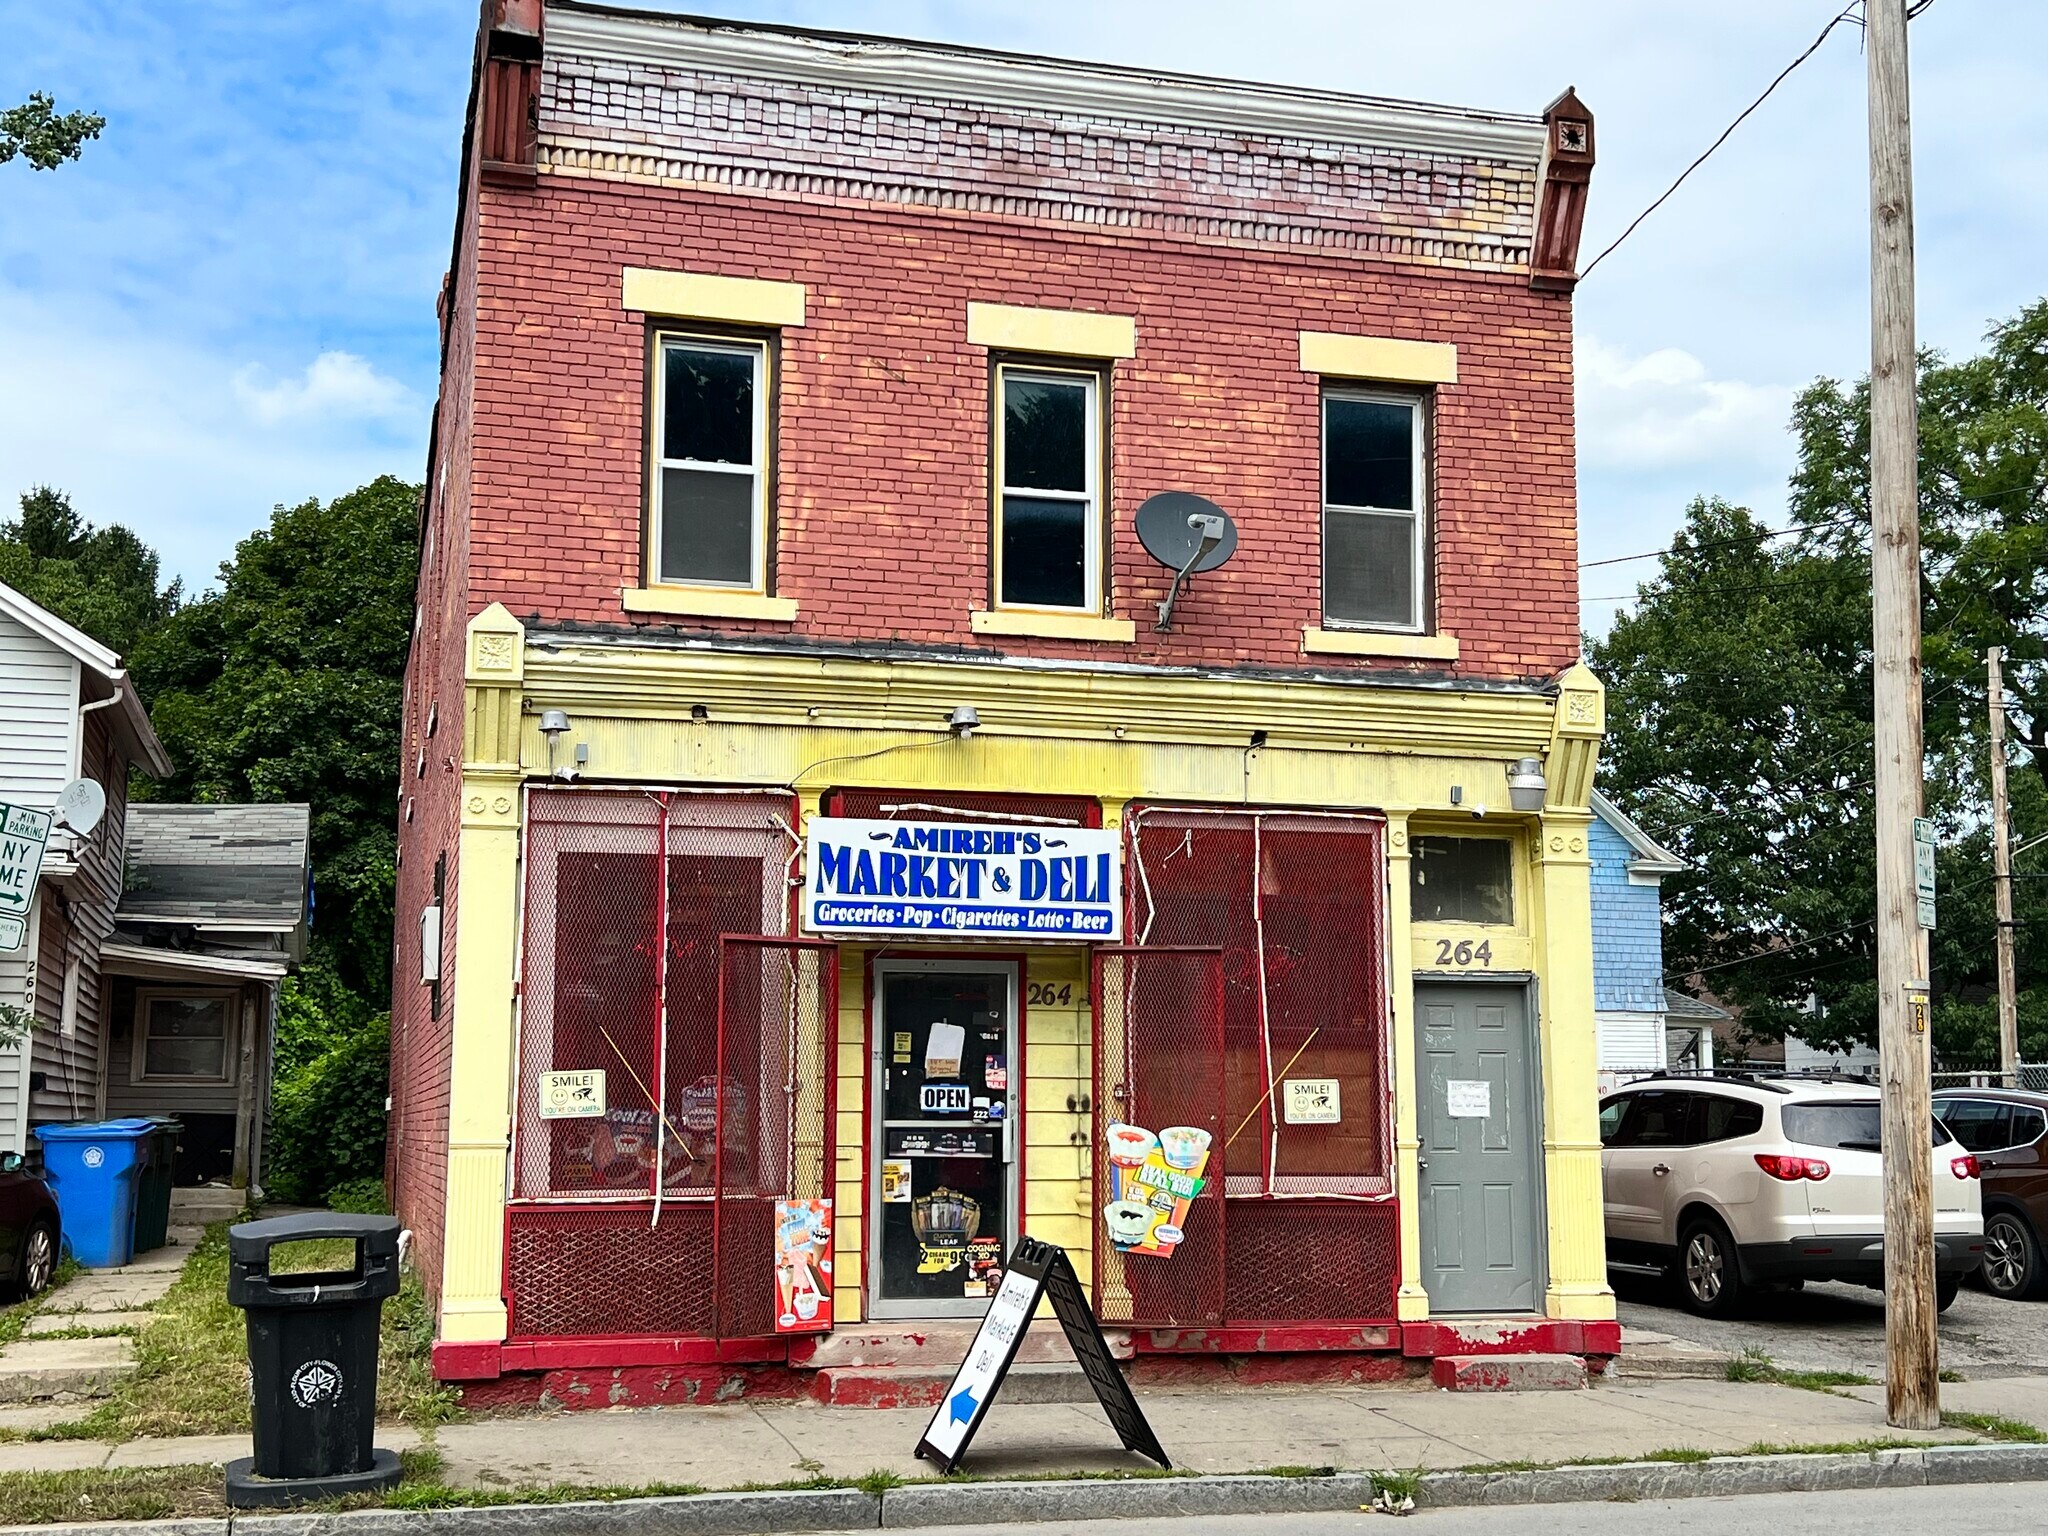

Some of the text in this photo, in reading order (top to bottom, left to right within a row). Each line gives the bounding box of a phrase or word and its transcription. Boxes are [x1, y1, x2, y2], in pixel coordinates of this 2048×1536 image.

[19, 811, 37, 825] MIN
[9, 820, 44, 840] PARKING
[892, 827, 1041, 855] AMIREH'S
[2, 840, 31, 863] NY
[0, 865, 28, 888] ME
[815, 842, 1111, 903] MARKET & DELI
[818, 903, 1109, 930] Groceries Pop Cigarettes Lotto Beer
[0, 924, 18, 933] HERS
[1435, 939, 1492, 966] 264
[25, 961, 36, 1004] 260
[1028, 982, 1071, 1006] 264
[551, 1075, 594, 1088] SMILE!
[1294, 1085, 1330, 1095] SMILE!
[924, 1088, 966, 1108] OPEN
[544, 1106, 566, 1114] YOU'RE
[578, 1105, 601, 1113] CAMERA
[1139, 1171, 1169, 1190] REAL
[1141, 1164, 1167, 1178] REAL
[966, 1244, 1001, 1253] COGNAC
[977, 1252, 990, 1260] XO
